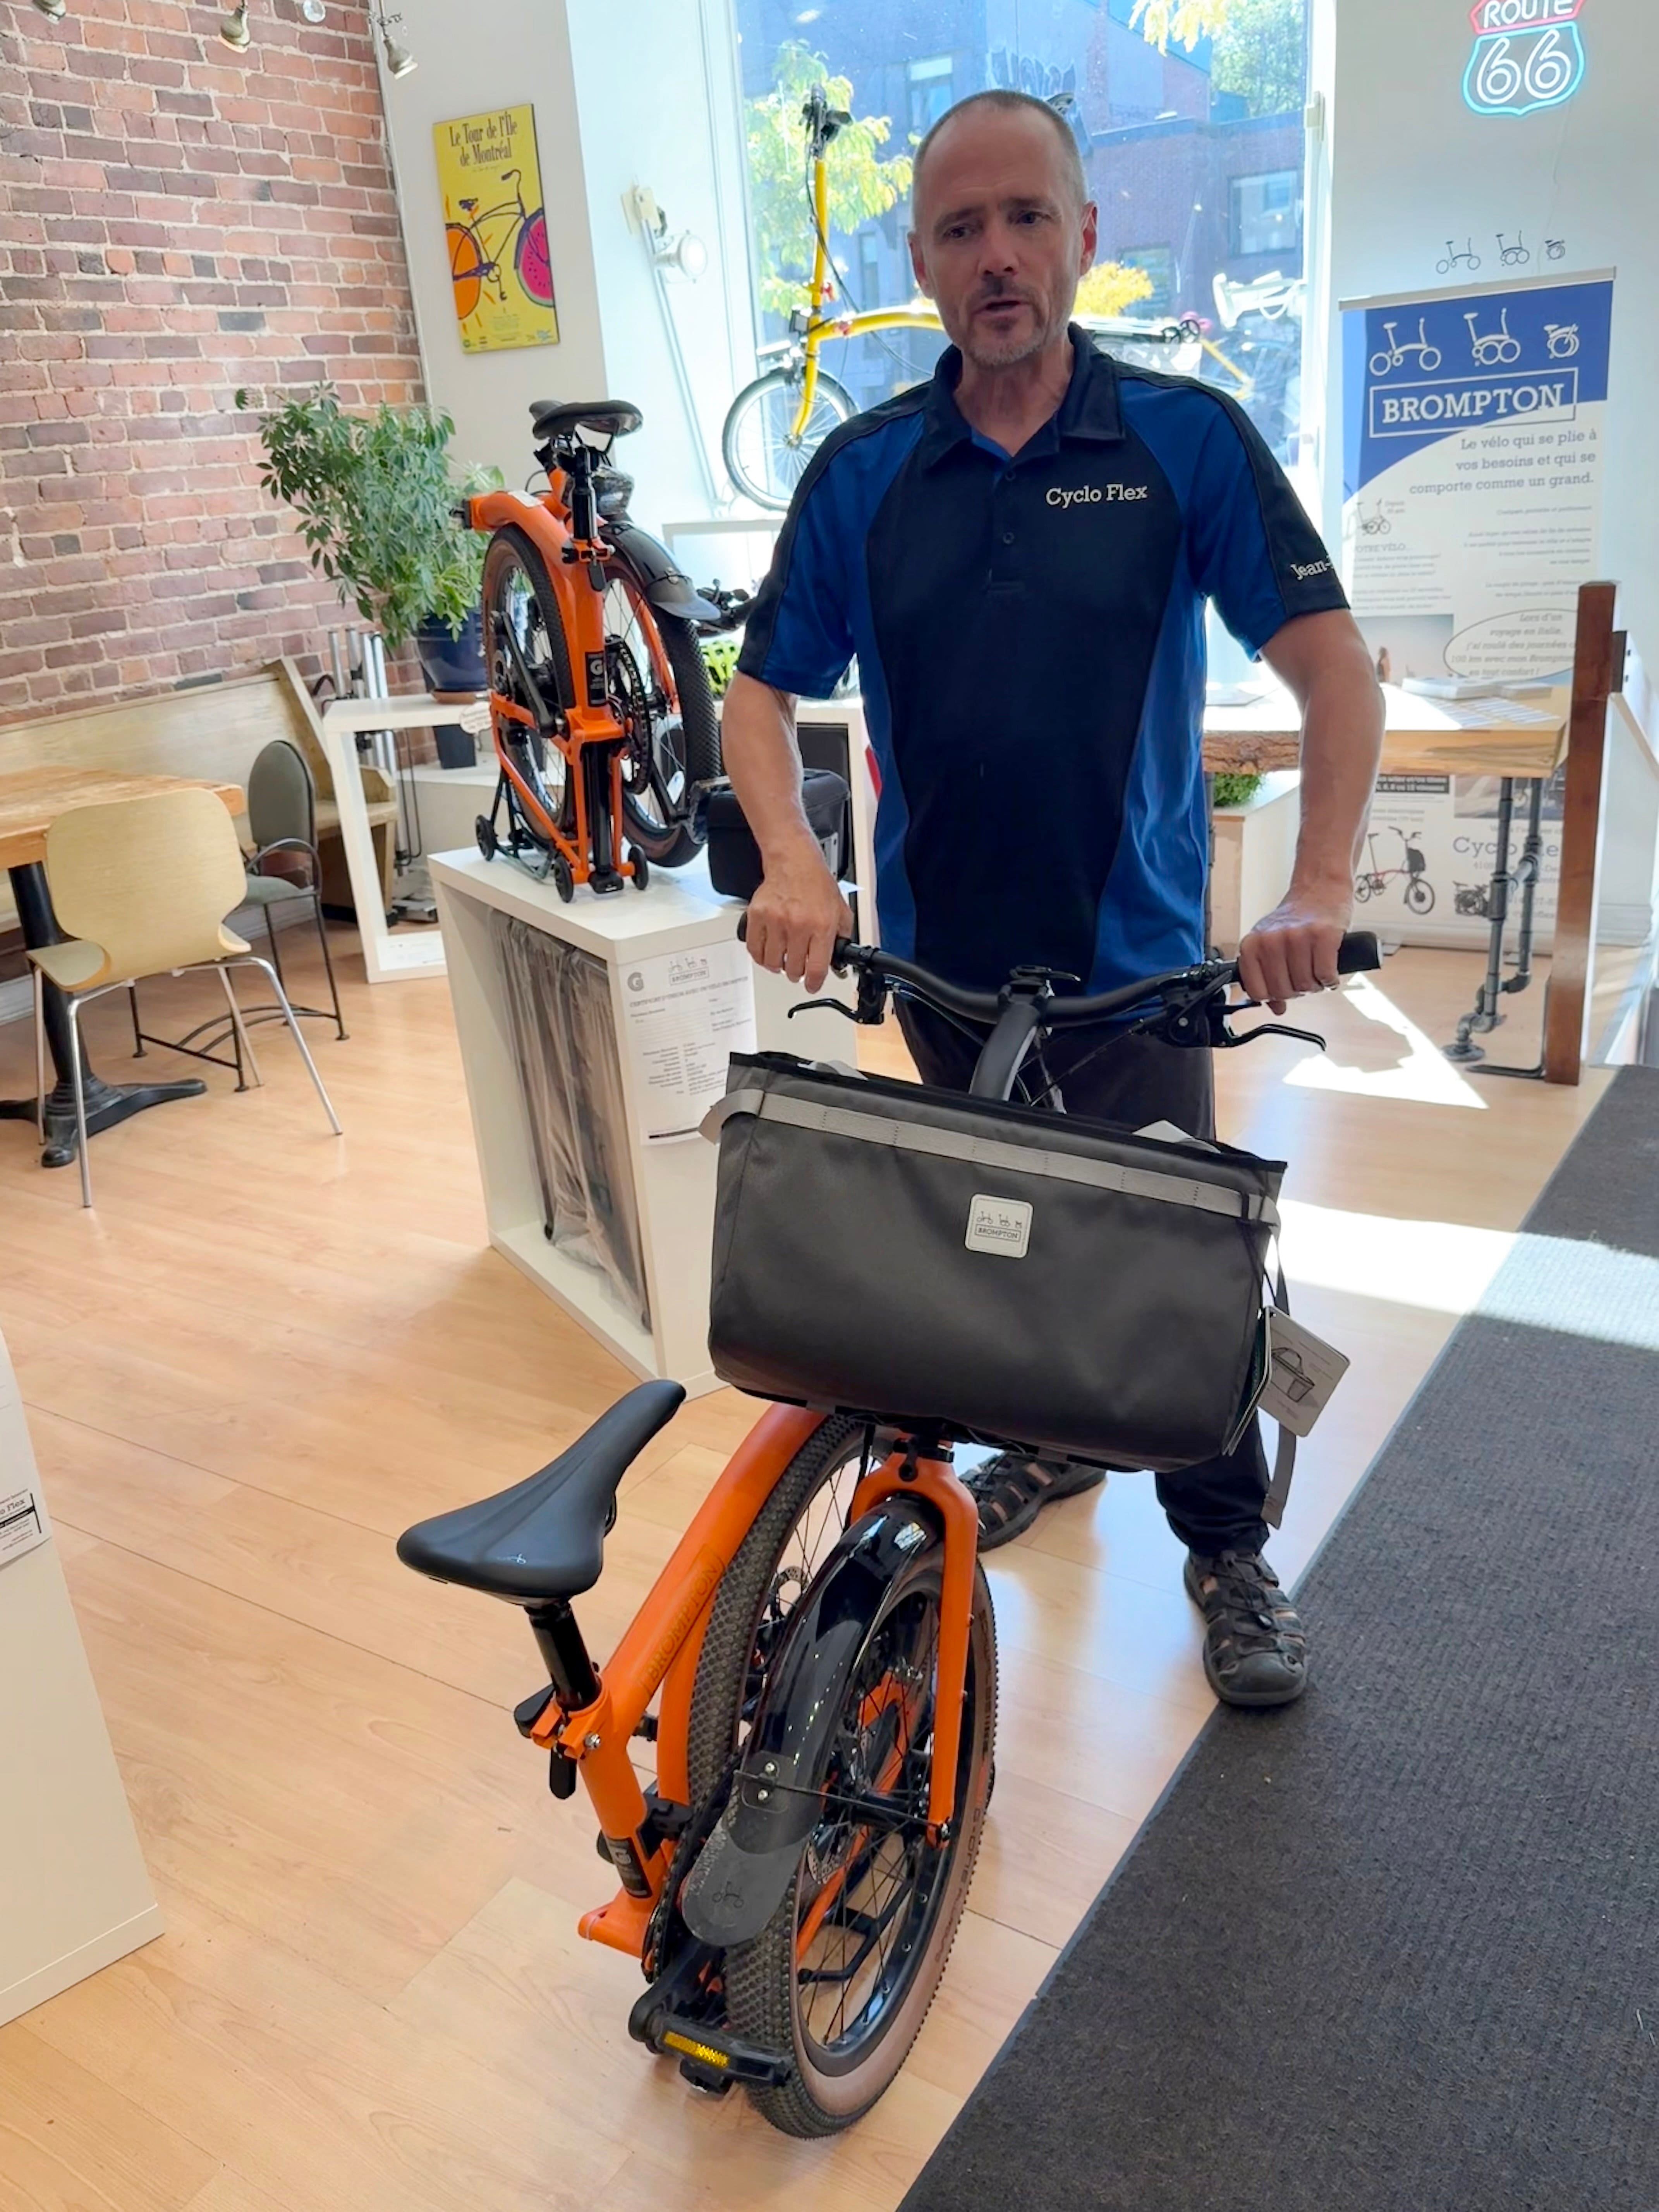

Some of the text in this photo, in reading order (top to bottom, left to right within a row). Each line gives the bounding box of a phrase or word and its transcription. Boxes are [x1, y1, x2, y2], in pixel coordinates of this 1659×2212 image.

[1484, 0, 1572, 28] ROUTE
[1477, 28, 1571, 105] 66
[449, 126, 460, 147] Le
[462, 123, 483, 143] Tour
[486, 118, 497, 139] de
[460, 137, 512, 167] de Montréal
[1382, 384, 1564, 423] BROMPTON
[1462, 429, 1597, 450] Le vélo qui se plie à
[1456, 452, 1595, 471] vos besoins et qui se
[1410, 471, 1594, 495] comporte comme un grand.
[1046, 484, 1147, 509] Cyclo Flex
[1290, 559, 1333, 580] Jean-
[1453, 836, 1517, 858] Cyco
[978, 1228, 1018, 1238] BROMPTON
[648, 1559, 721, 1683] BROMPTON
